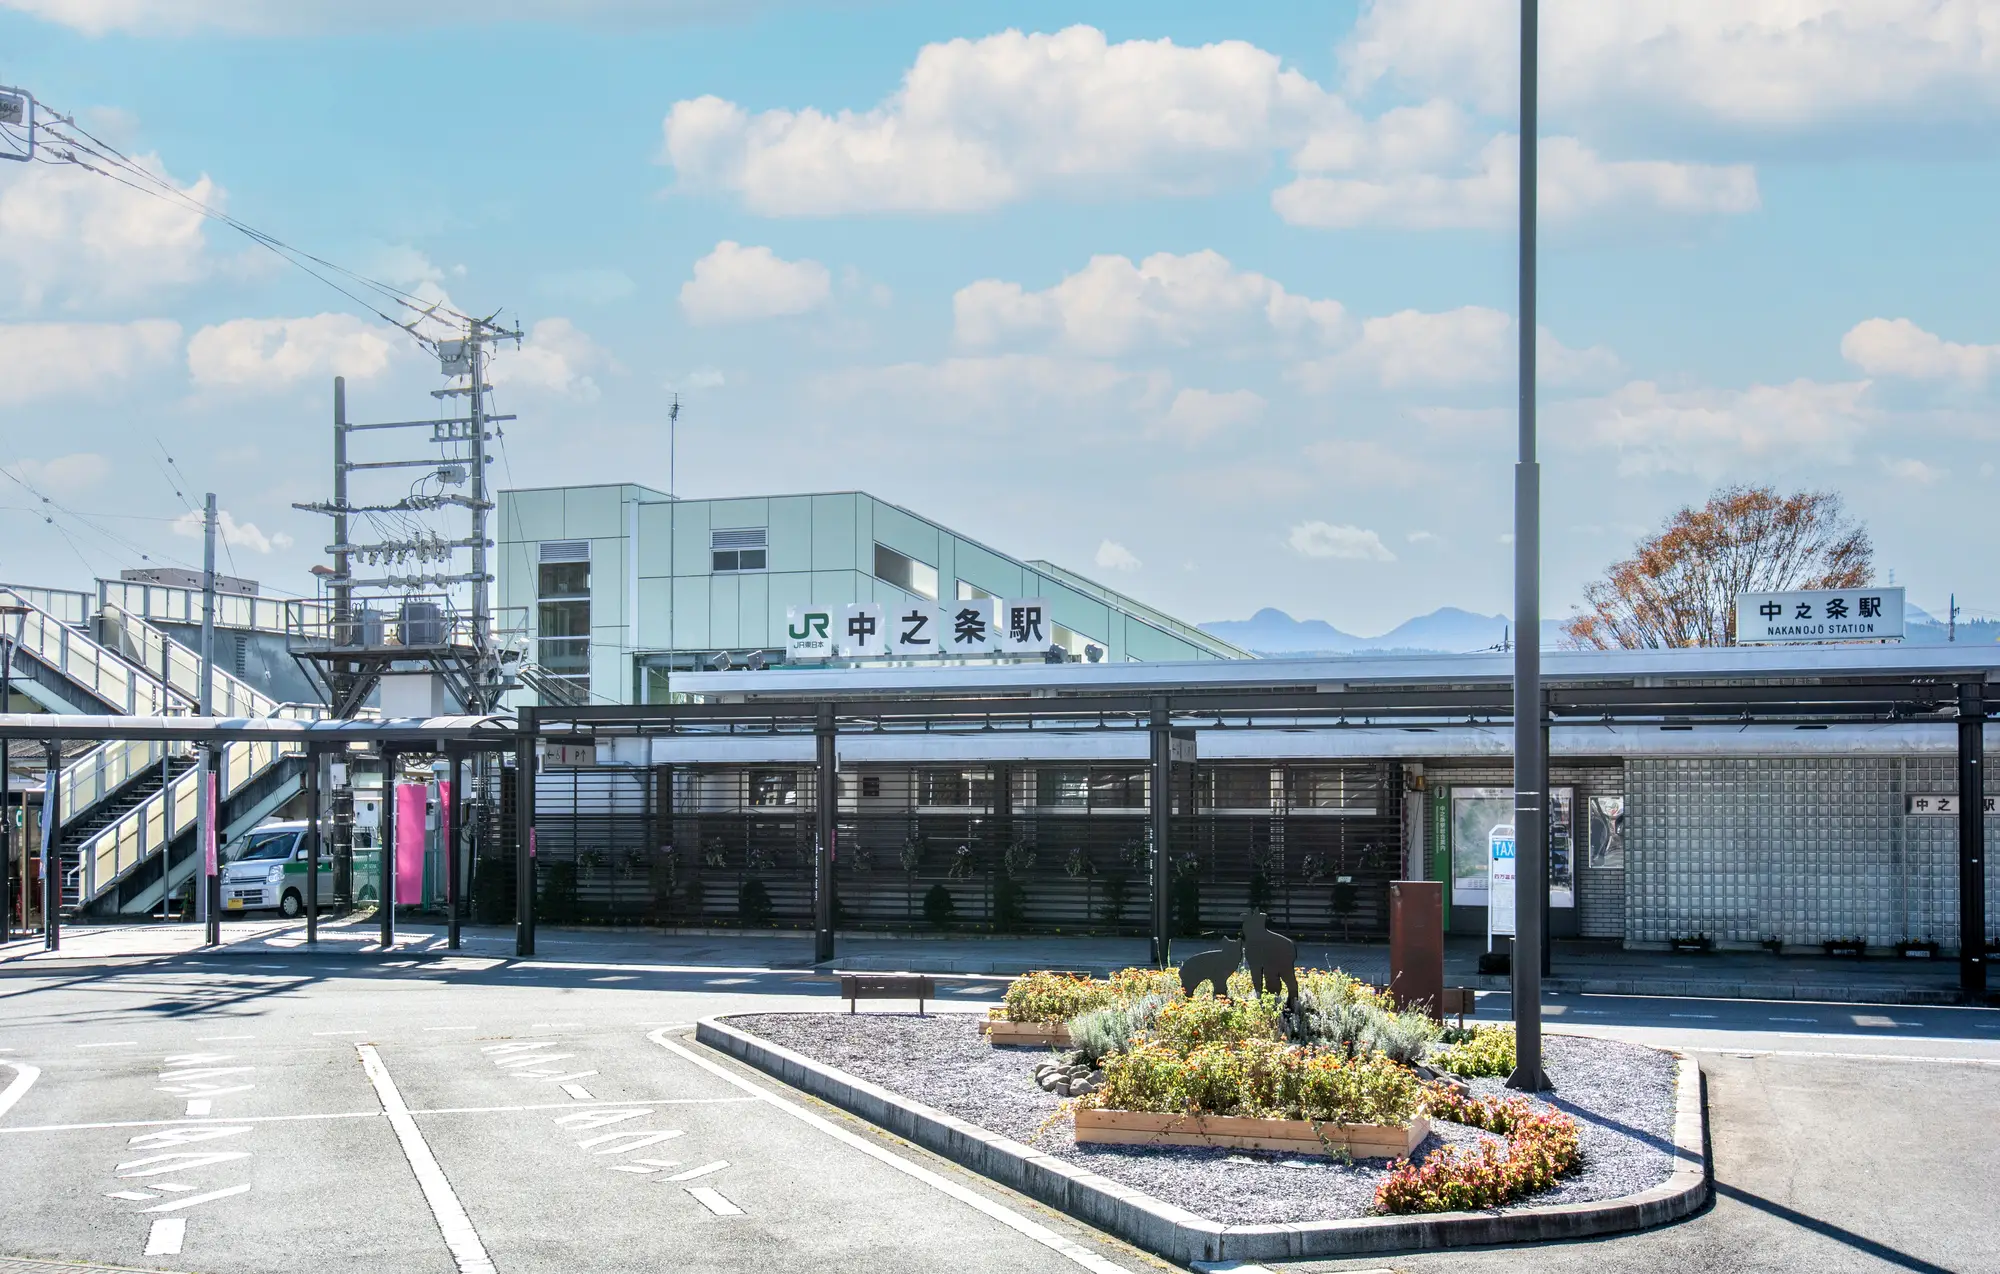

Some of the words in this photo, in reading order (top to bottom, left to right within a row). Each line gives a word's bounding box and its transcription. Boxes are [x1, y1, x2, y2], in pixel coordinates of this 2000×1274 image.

[1760, 596, 1882, 622] 中之条駅
[788, 612, 830, 640] JR
[847, 606, 1044, 647] 中之条駅
[1828, 623, 1874, 634] STATION
[793, 640, 825, 649] JR東日本
[575, 750, 580, 760] P
[1916, 798, 1995, 812] 中之駅
[1495, 841, 1514, 857] TAX
